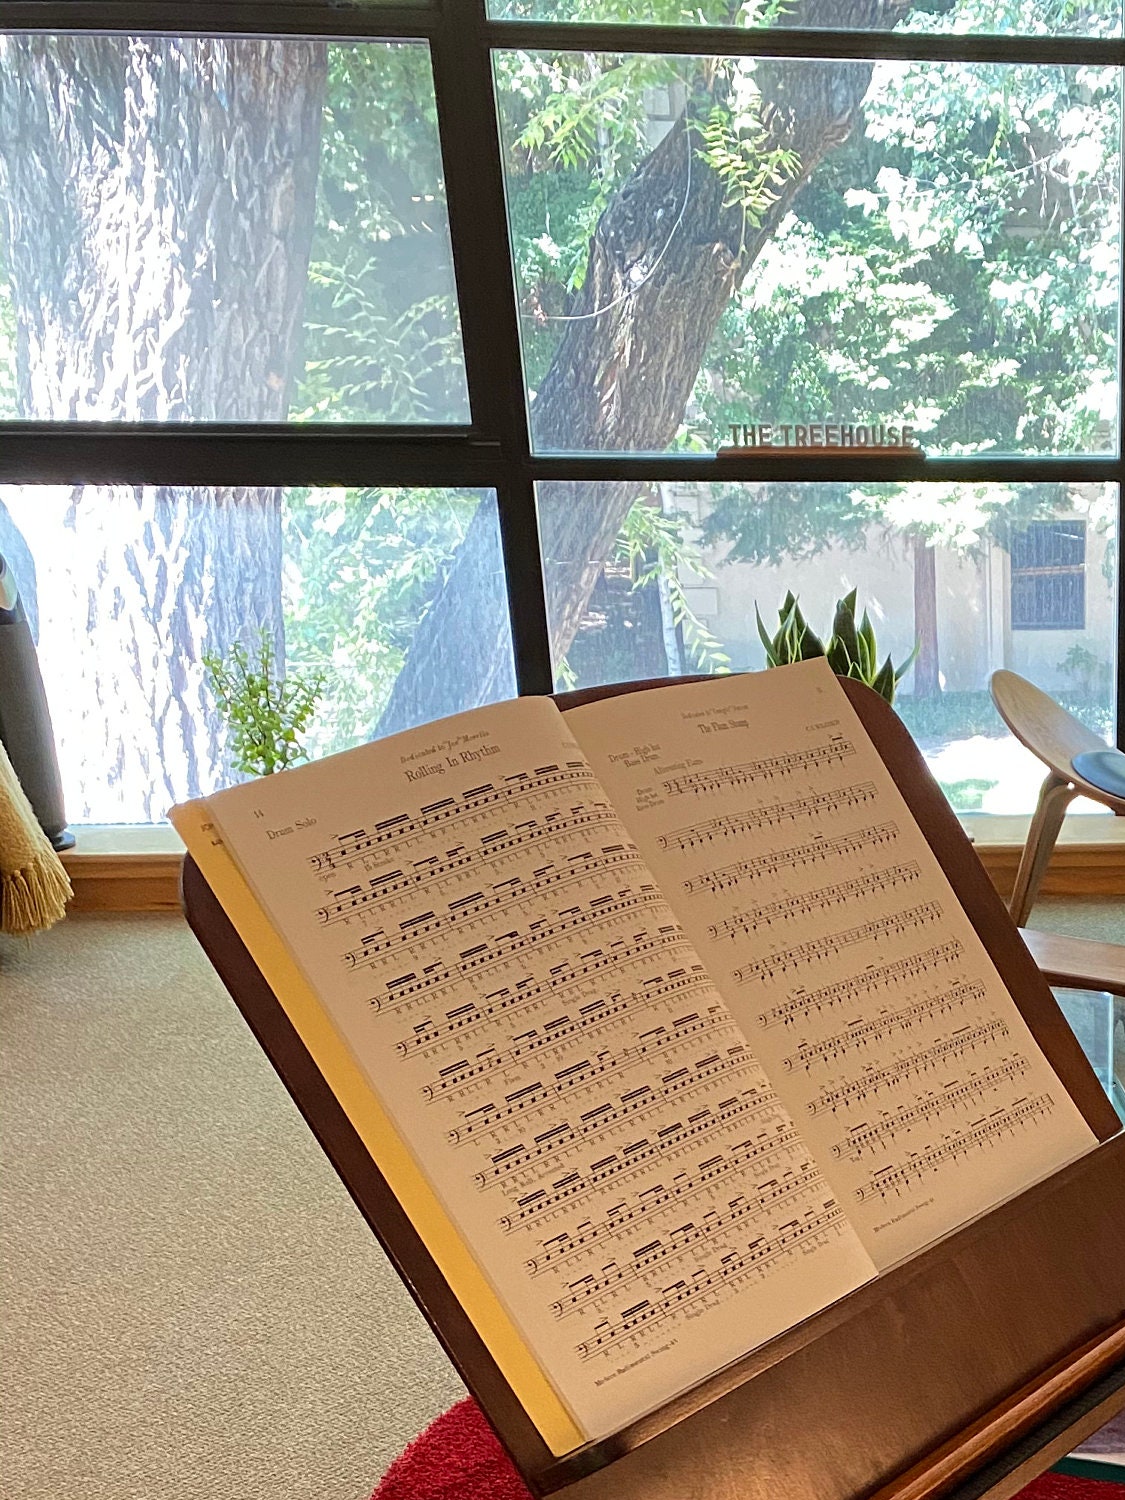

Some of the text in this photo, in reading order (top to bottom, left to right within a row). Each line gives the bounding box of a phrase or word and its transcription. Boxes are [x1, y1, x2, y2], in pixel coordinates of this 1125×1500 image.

[728, 424, 914, 446] THE TREEHOUSE
[405, 745, 501, 782] Rolling In Rhythm
[266, 817, 317, 840] Drum Solo
